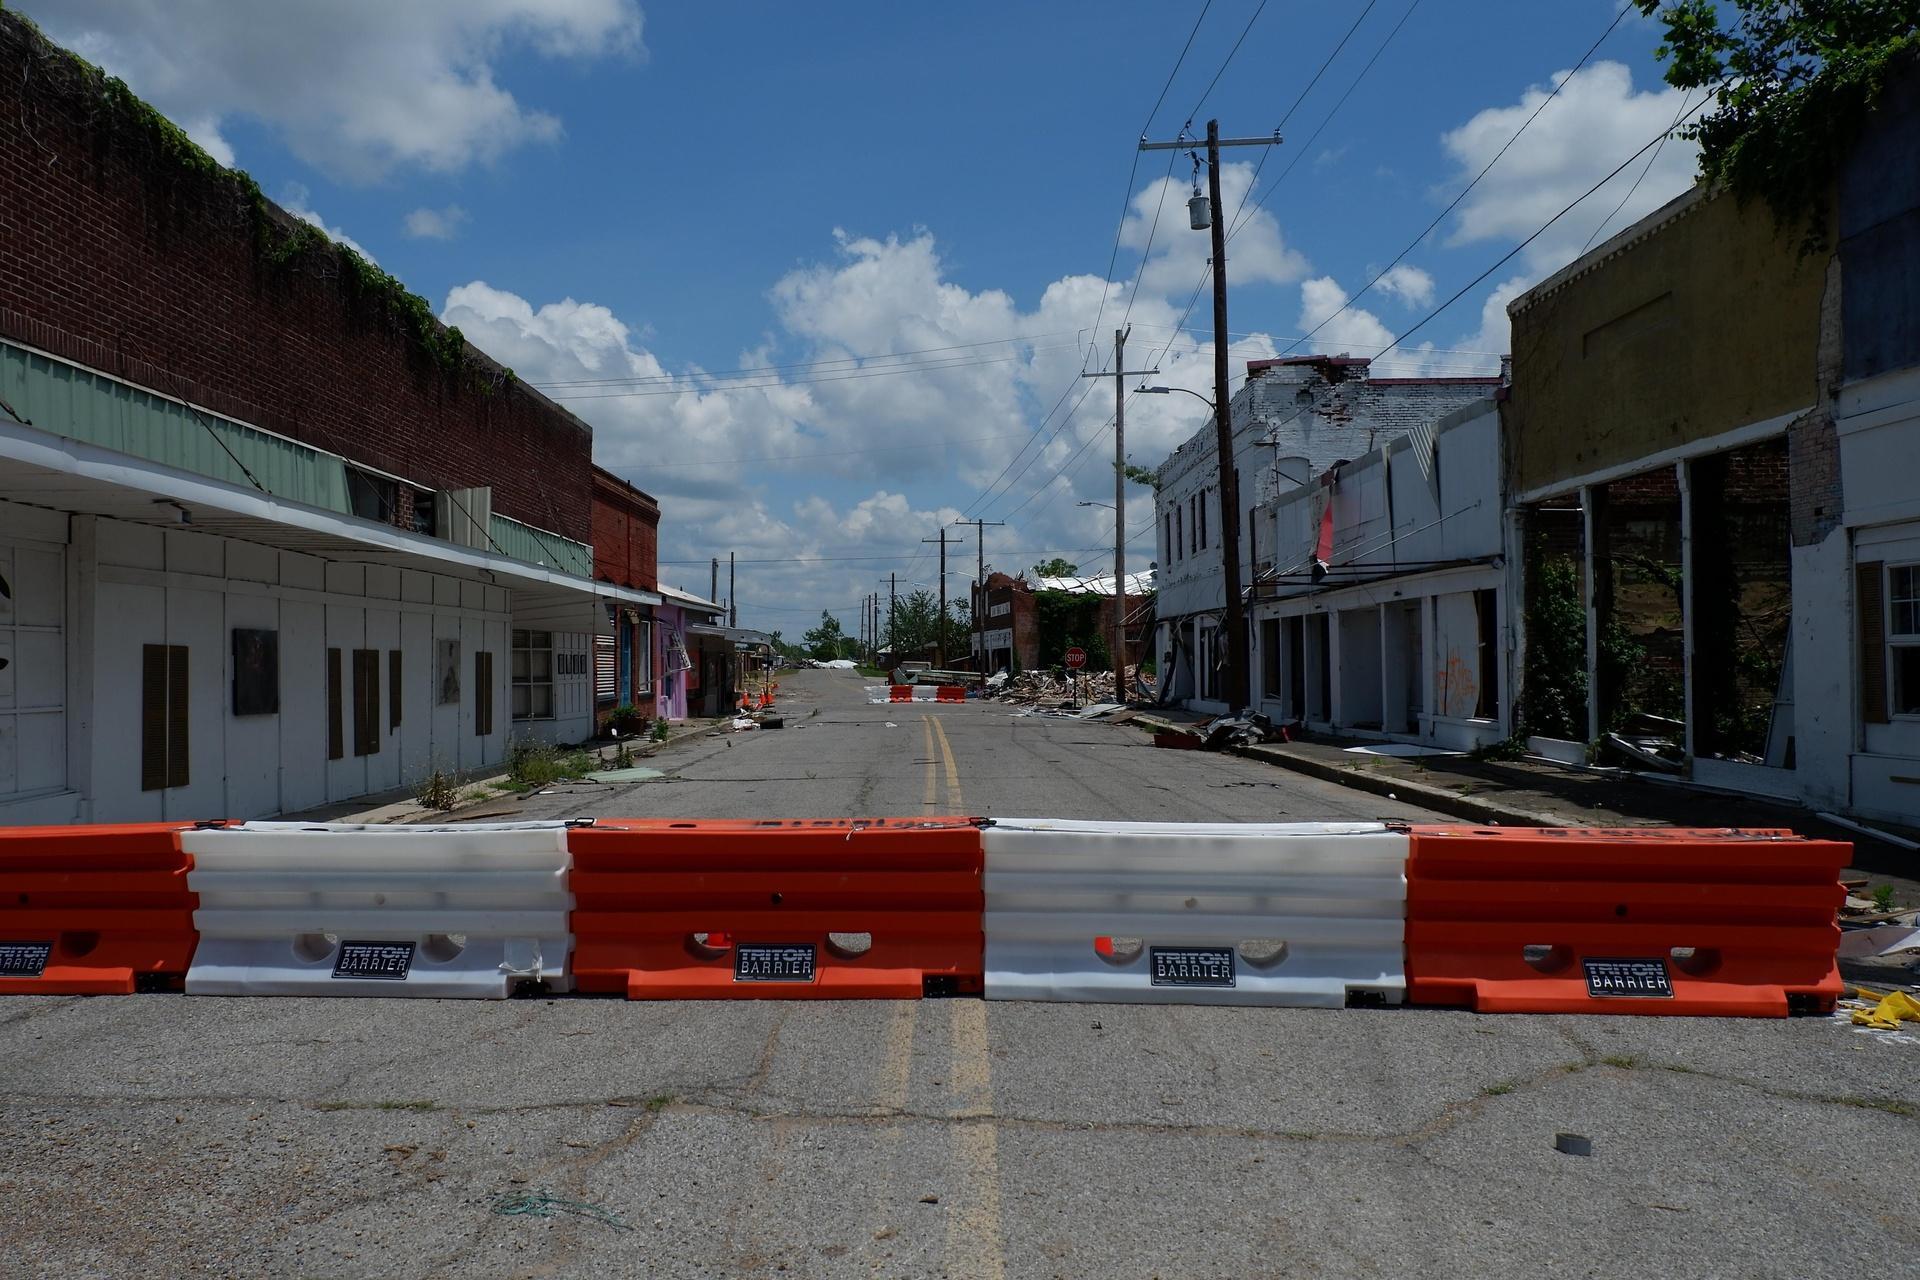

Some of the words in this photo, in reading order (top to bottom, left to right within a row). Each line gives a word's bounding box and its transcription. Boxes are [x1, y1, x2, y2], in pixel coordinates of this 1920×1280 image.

[1067, 653, 1085, 662] STOP
[0, 946, 49, 958] RITON
[343, 946, 411, 959] TRITON
[739, 949, 813, 961] TRITON
[1153, 952, 1230, 965] TRITON
[0, 958, 45, 969] RRIER
[340, 958, 407, 971] BARRIER
[741, 961, 811, 974] BARRIER
[1585, 963, 1665, 976] TRITON
[1157, 964, 1231, 978] BARRIER
[1592, 975, 1668, 989] BARRIER
